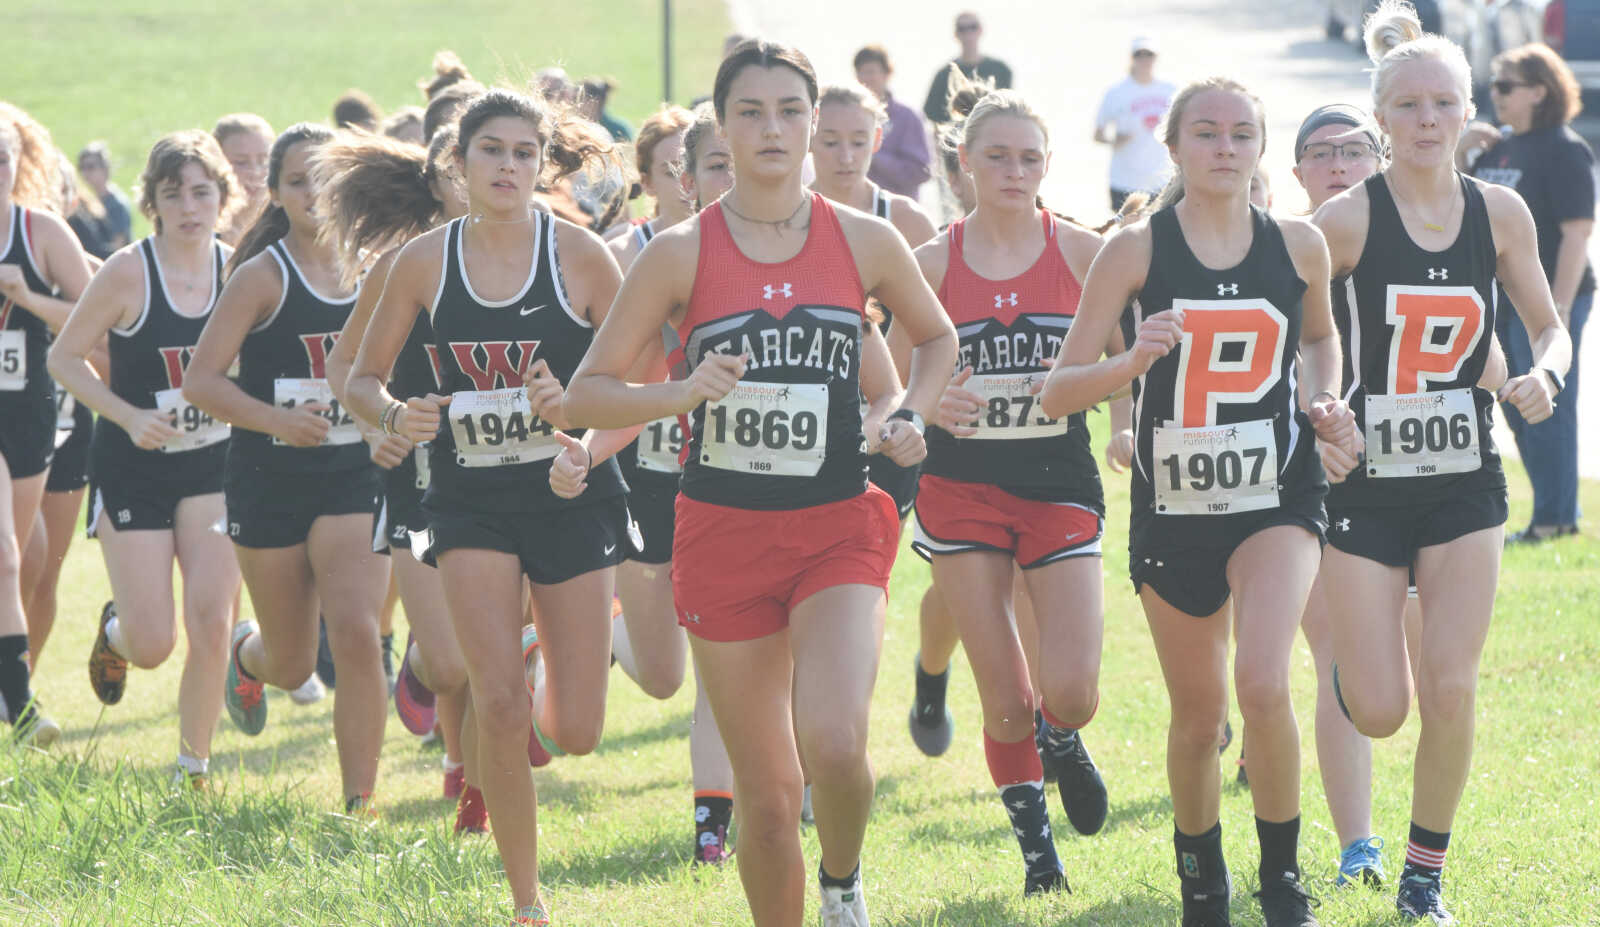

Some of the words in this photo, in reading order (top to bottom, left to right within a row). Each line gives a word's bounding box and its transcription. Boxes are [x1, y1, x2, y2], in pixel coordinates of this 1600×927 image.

[954, 332, 1063, 376] EARCAT
[1386, 284, 1485, 394] P
[448, 340, 541, 391] W
[1164, 298, 1289, 428] P
[457, 411, 553, 445] 1944
[710, 405, 818, 450] 1869
[1374, 413, 1471, 455] 1906
[749, 461, 772, 471] 1869
[1162, 447, 1267, 491] 1907
[1207, 502, 1230, 512] 1907
